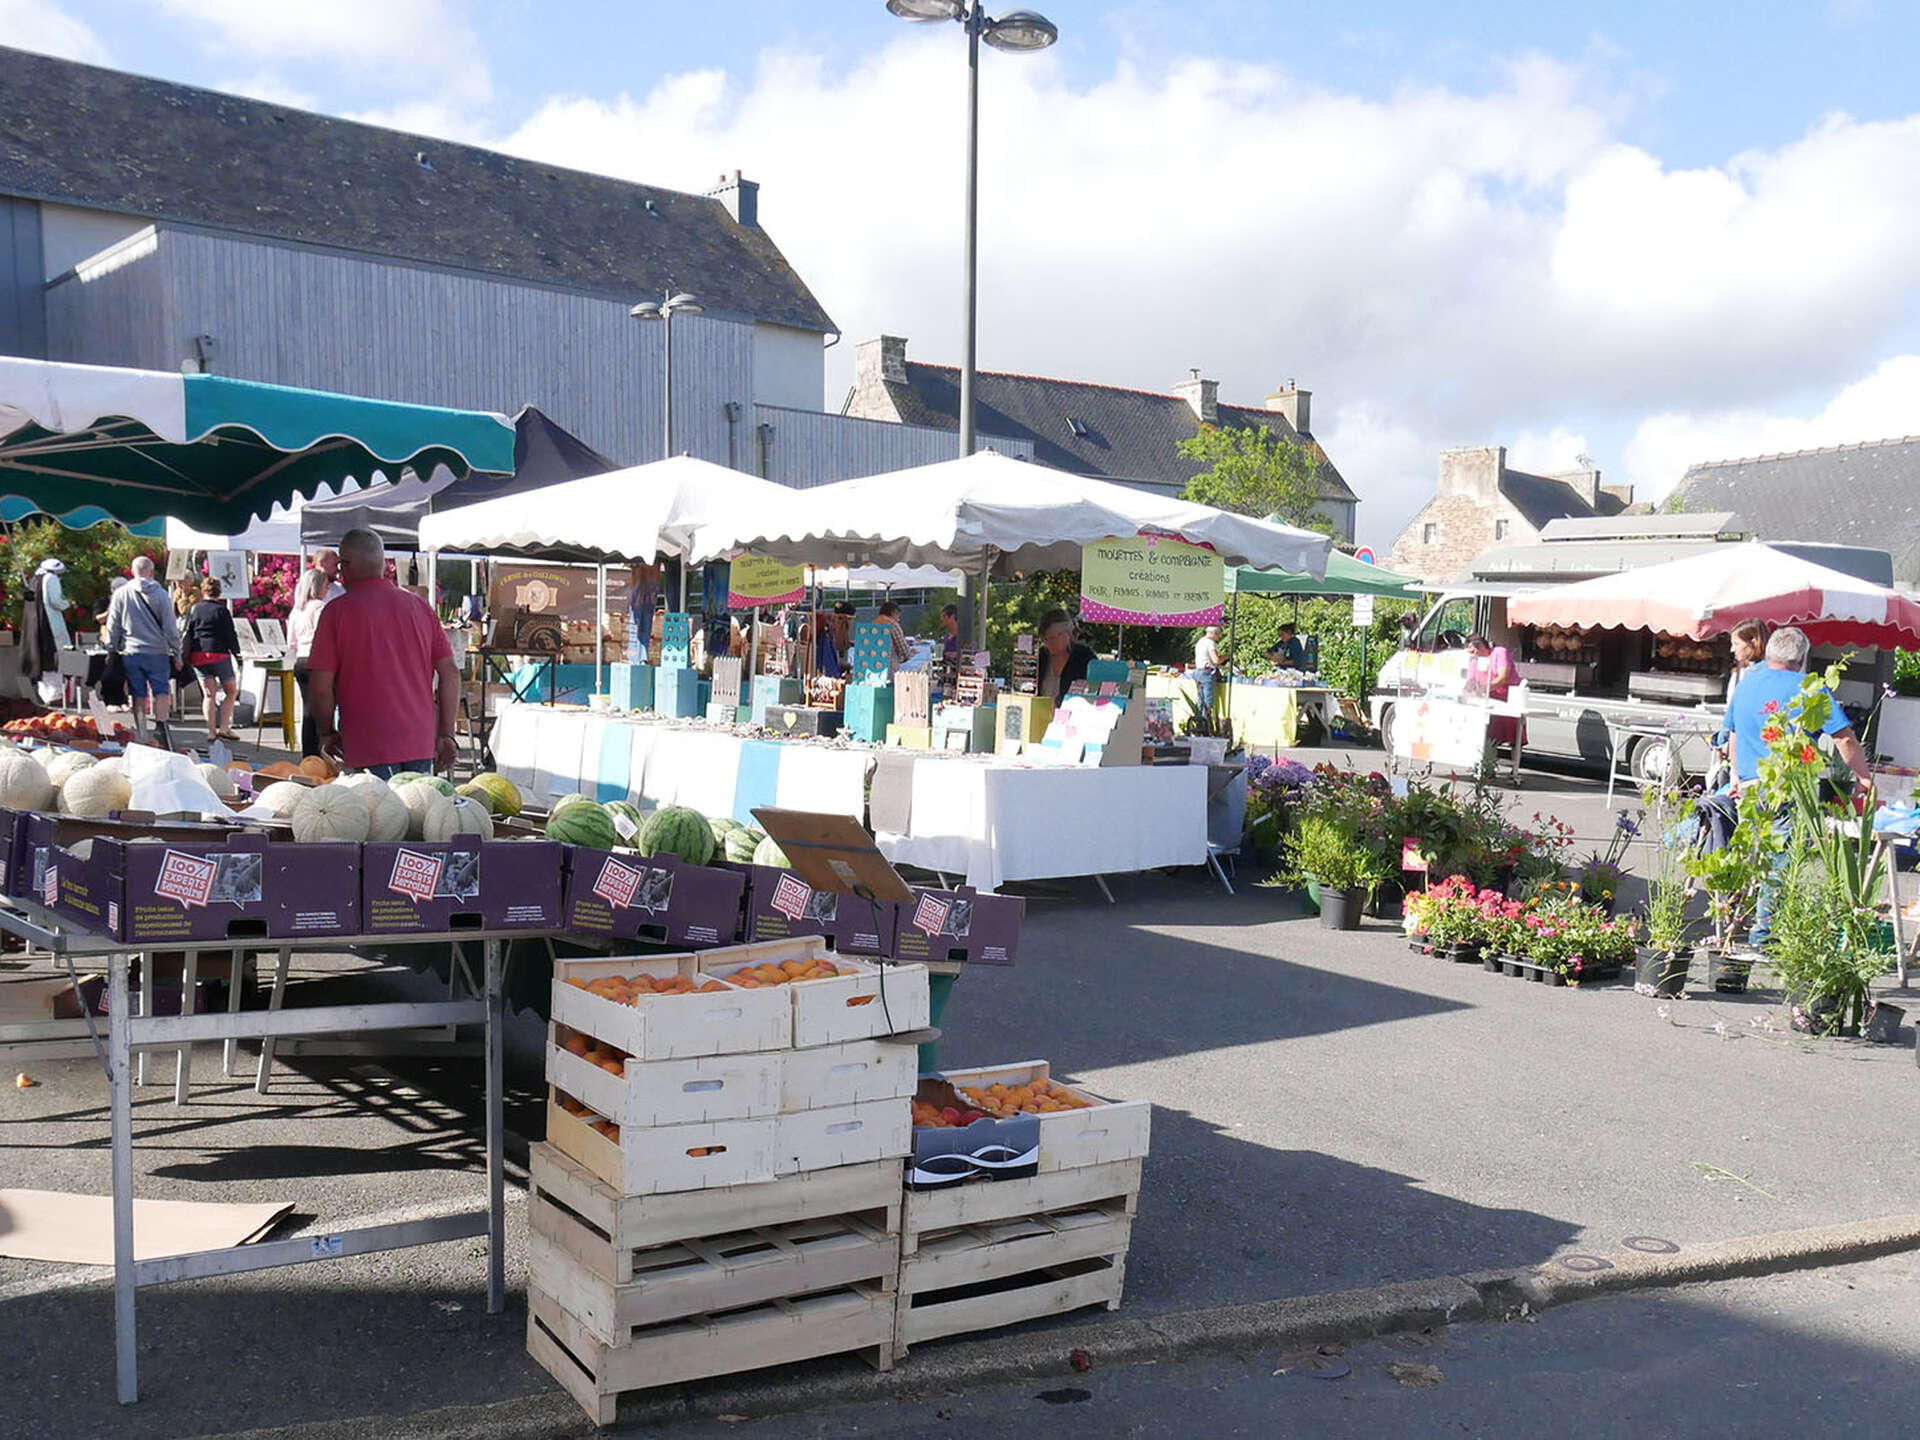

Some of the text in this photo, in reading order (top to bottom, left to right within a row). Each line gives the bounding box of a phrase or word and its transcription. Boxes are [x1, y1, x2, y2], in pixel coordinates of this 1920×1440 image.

[1148, 550, 1158, 565] &
[170, 857, 210, 880] 100%
[401, 855, 435, 874] 100%
[607, 864, 636, 884] 100%
[164, 871, 207, 890] EXPERTS
[396, 867, 432, 884] EXPERTS
[783, 879, 806, 898] 100%
